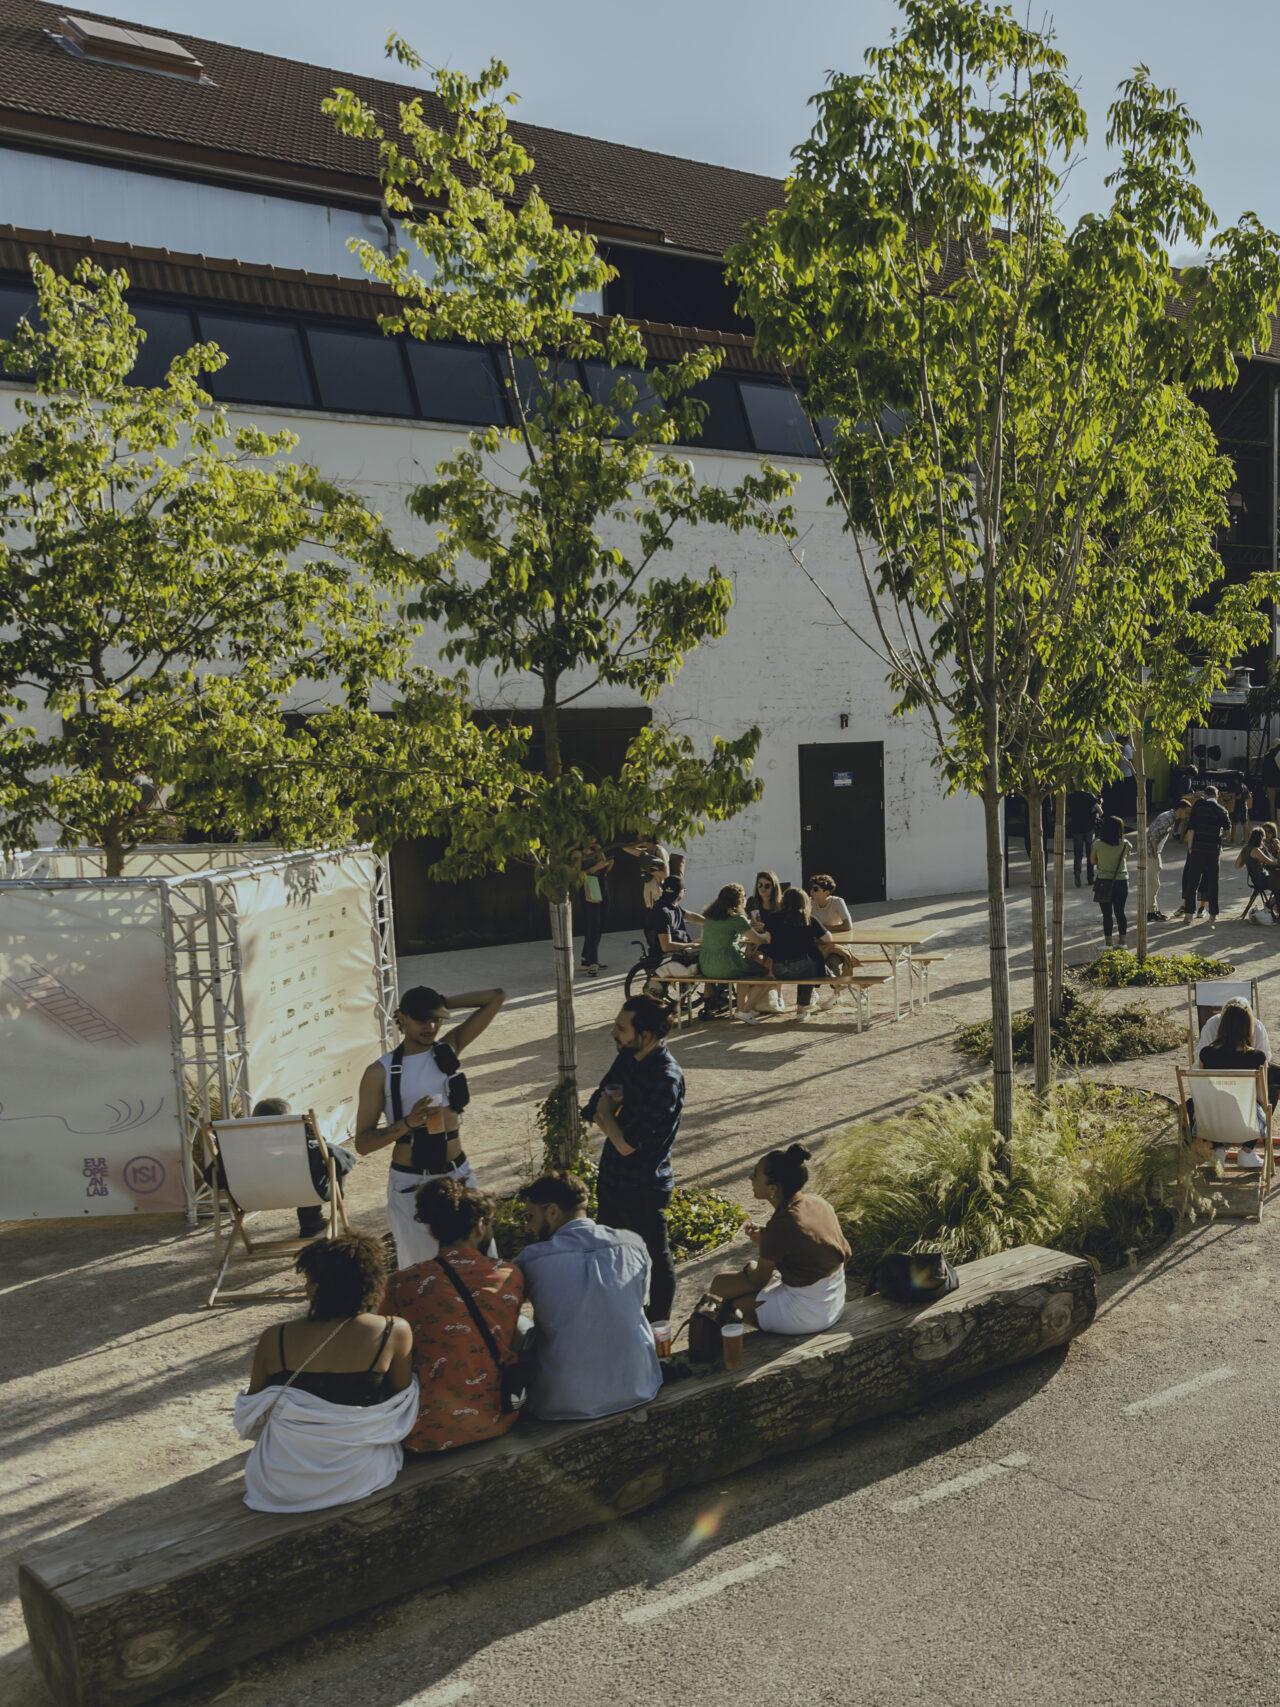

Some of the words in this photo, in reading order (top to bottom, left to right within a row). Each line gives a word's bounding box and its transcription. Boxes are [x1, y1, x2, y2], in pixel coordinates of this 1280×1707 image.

[83, 1157, 106, 1168] EUR
[82, 1167, 109, 1177] OPE
[86, 1186, 109, 1197] LAB
